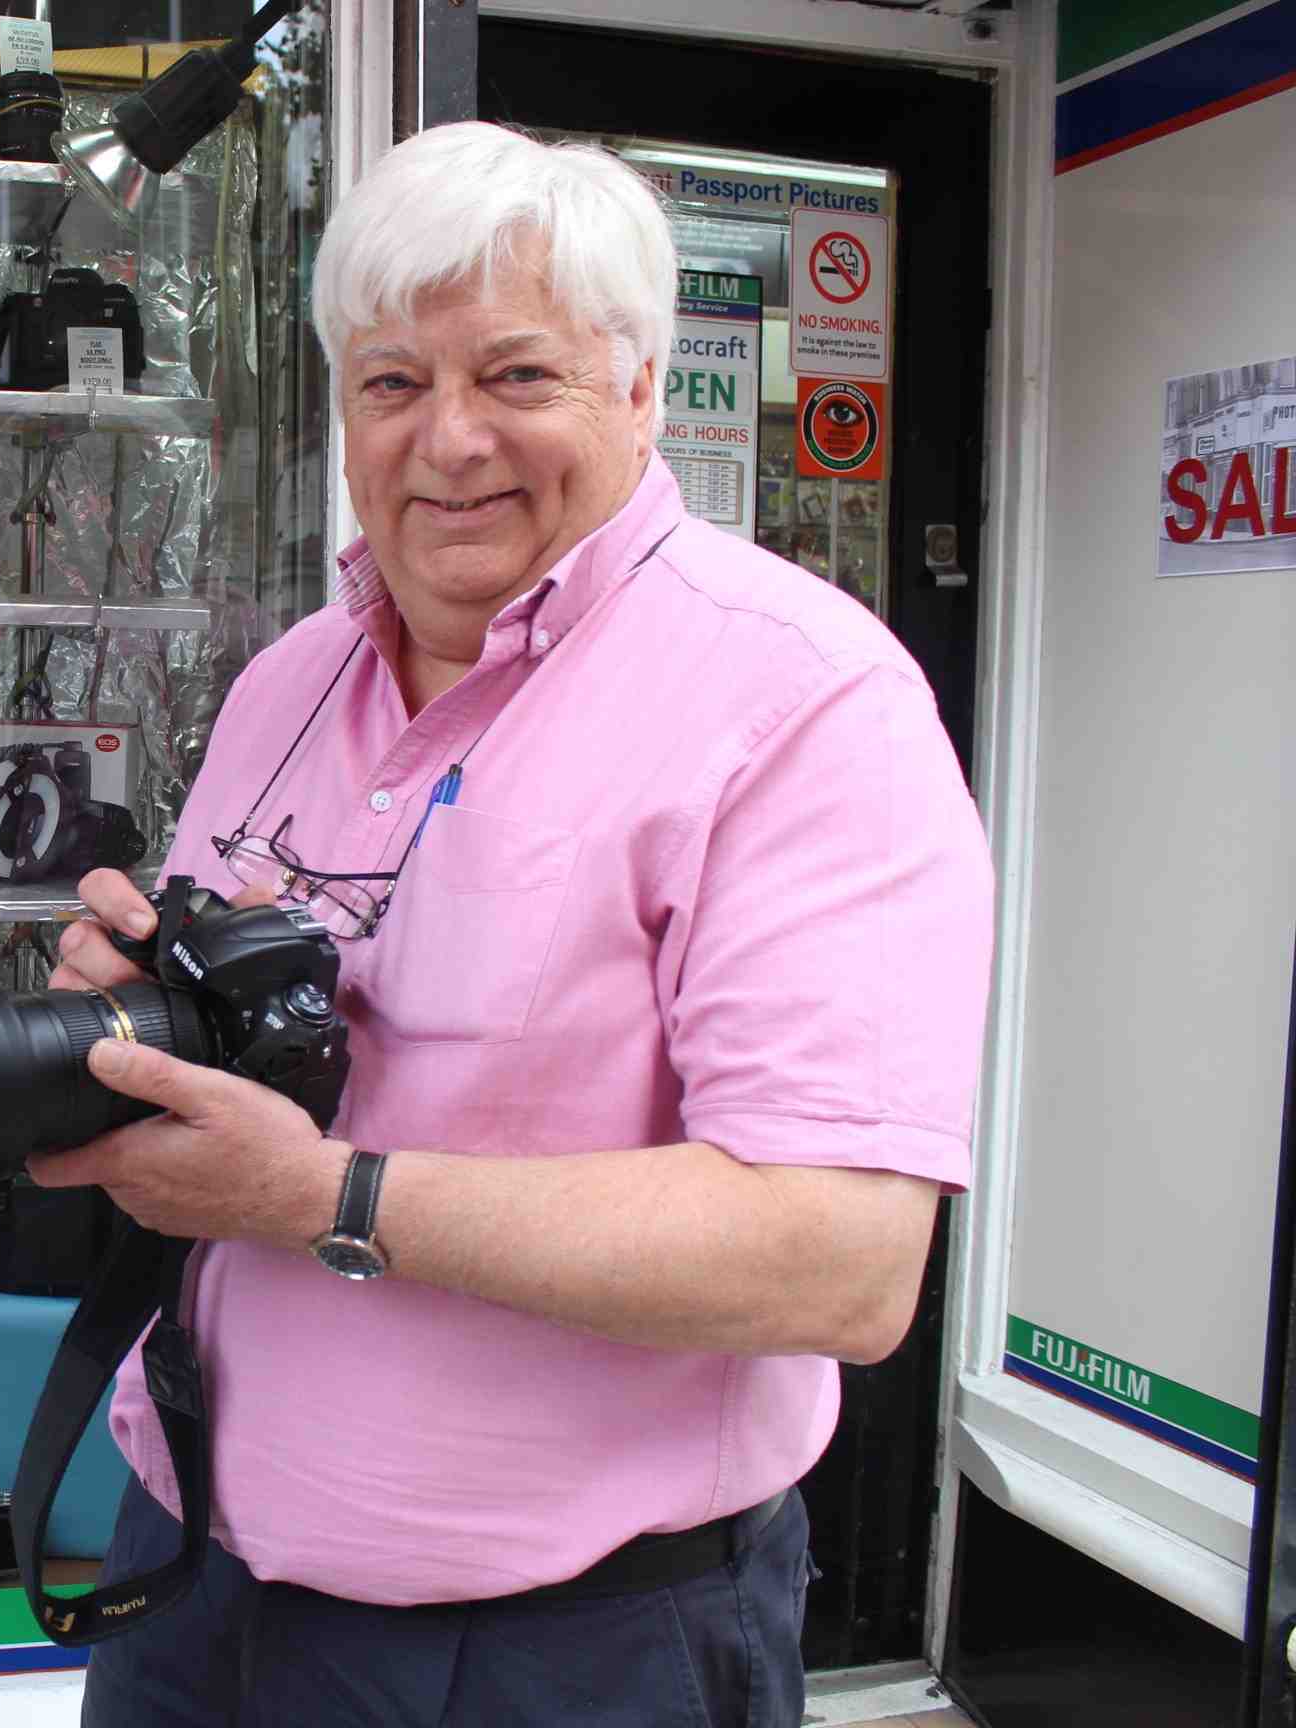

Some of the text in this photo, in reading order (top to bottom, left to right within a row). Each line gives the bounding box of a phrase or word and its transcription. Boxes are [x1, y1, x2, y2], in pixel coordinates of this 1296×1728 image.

[681, 171, 783, 203] Passport
[789, 182, 879, 213] Pictures
[675, 273, 739, 299] FILM
[799, 313, 817, 328] NO
[670, 335, 748, 360] ocraft
[817, 338, 842, 347] against
[664, 369, 736, 412] PEN
[662, 423, 749, 444] NG HOURS
[97, 738, 118, 746] EOS
[171, 940, 205, 981] Nikon
